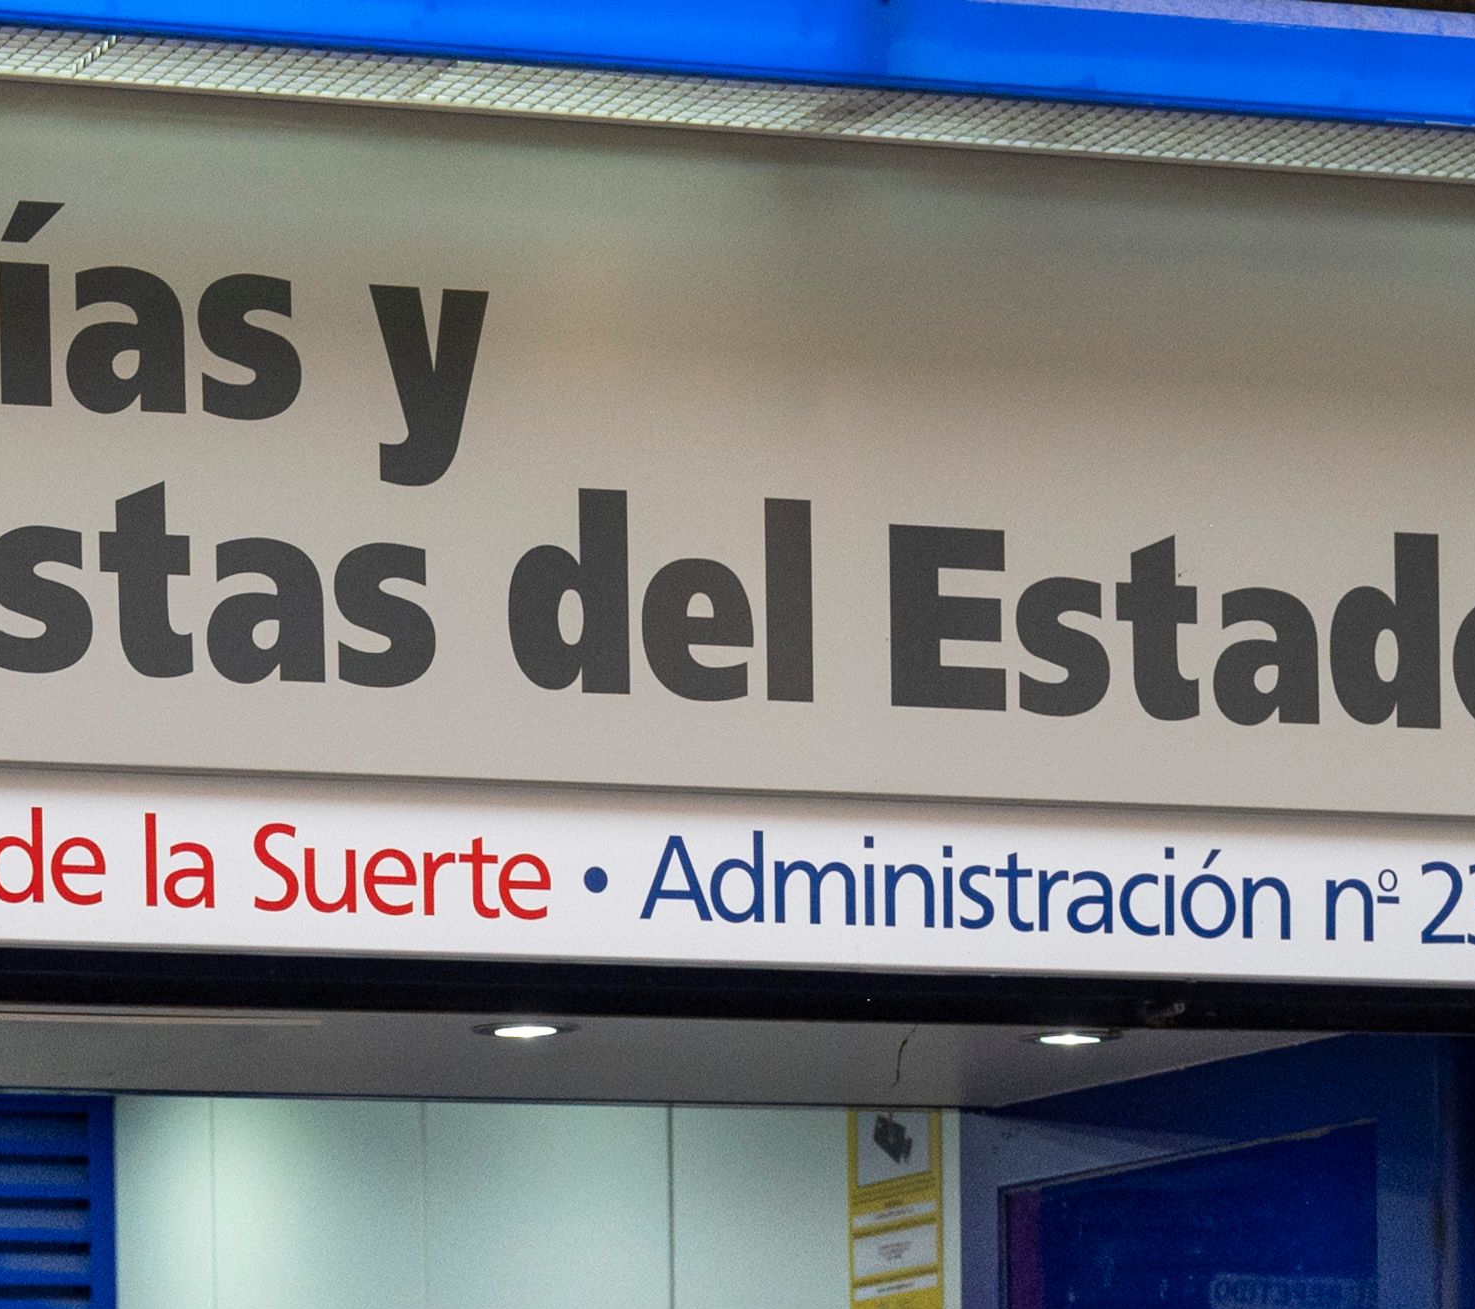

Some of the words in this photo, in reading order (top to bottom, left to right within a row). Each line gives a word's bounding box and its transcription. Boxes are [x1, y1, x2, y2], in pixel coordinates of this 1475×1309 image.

[367, 282, 491, 488] y
[506, 486, 815, 704] del
[141, 810, 218, 910] la
[252, 820, 553, 924] Suerte
[638, 828, 1294, 946] Administración
